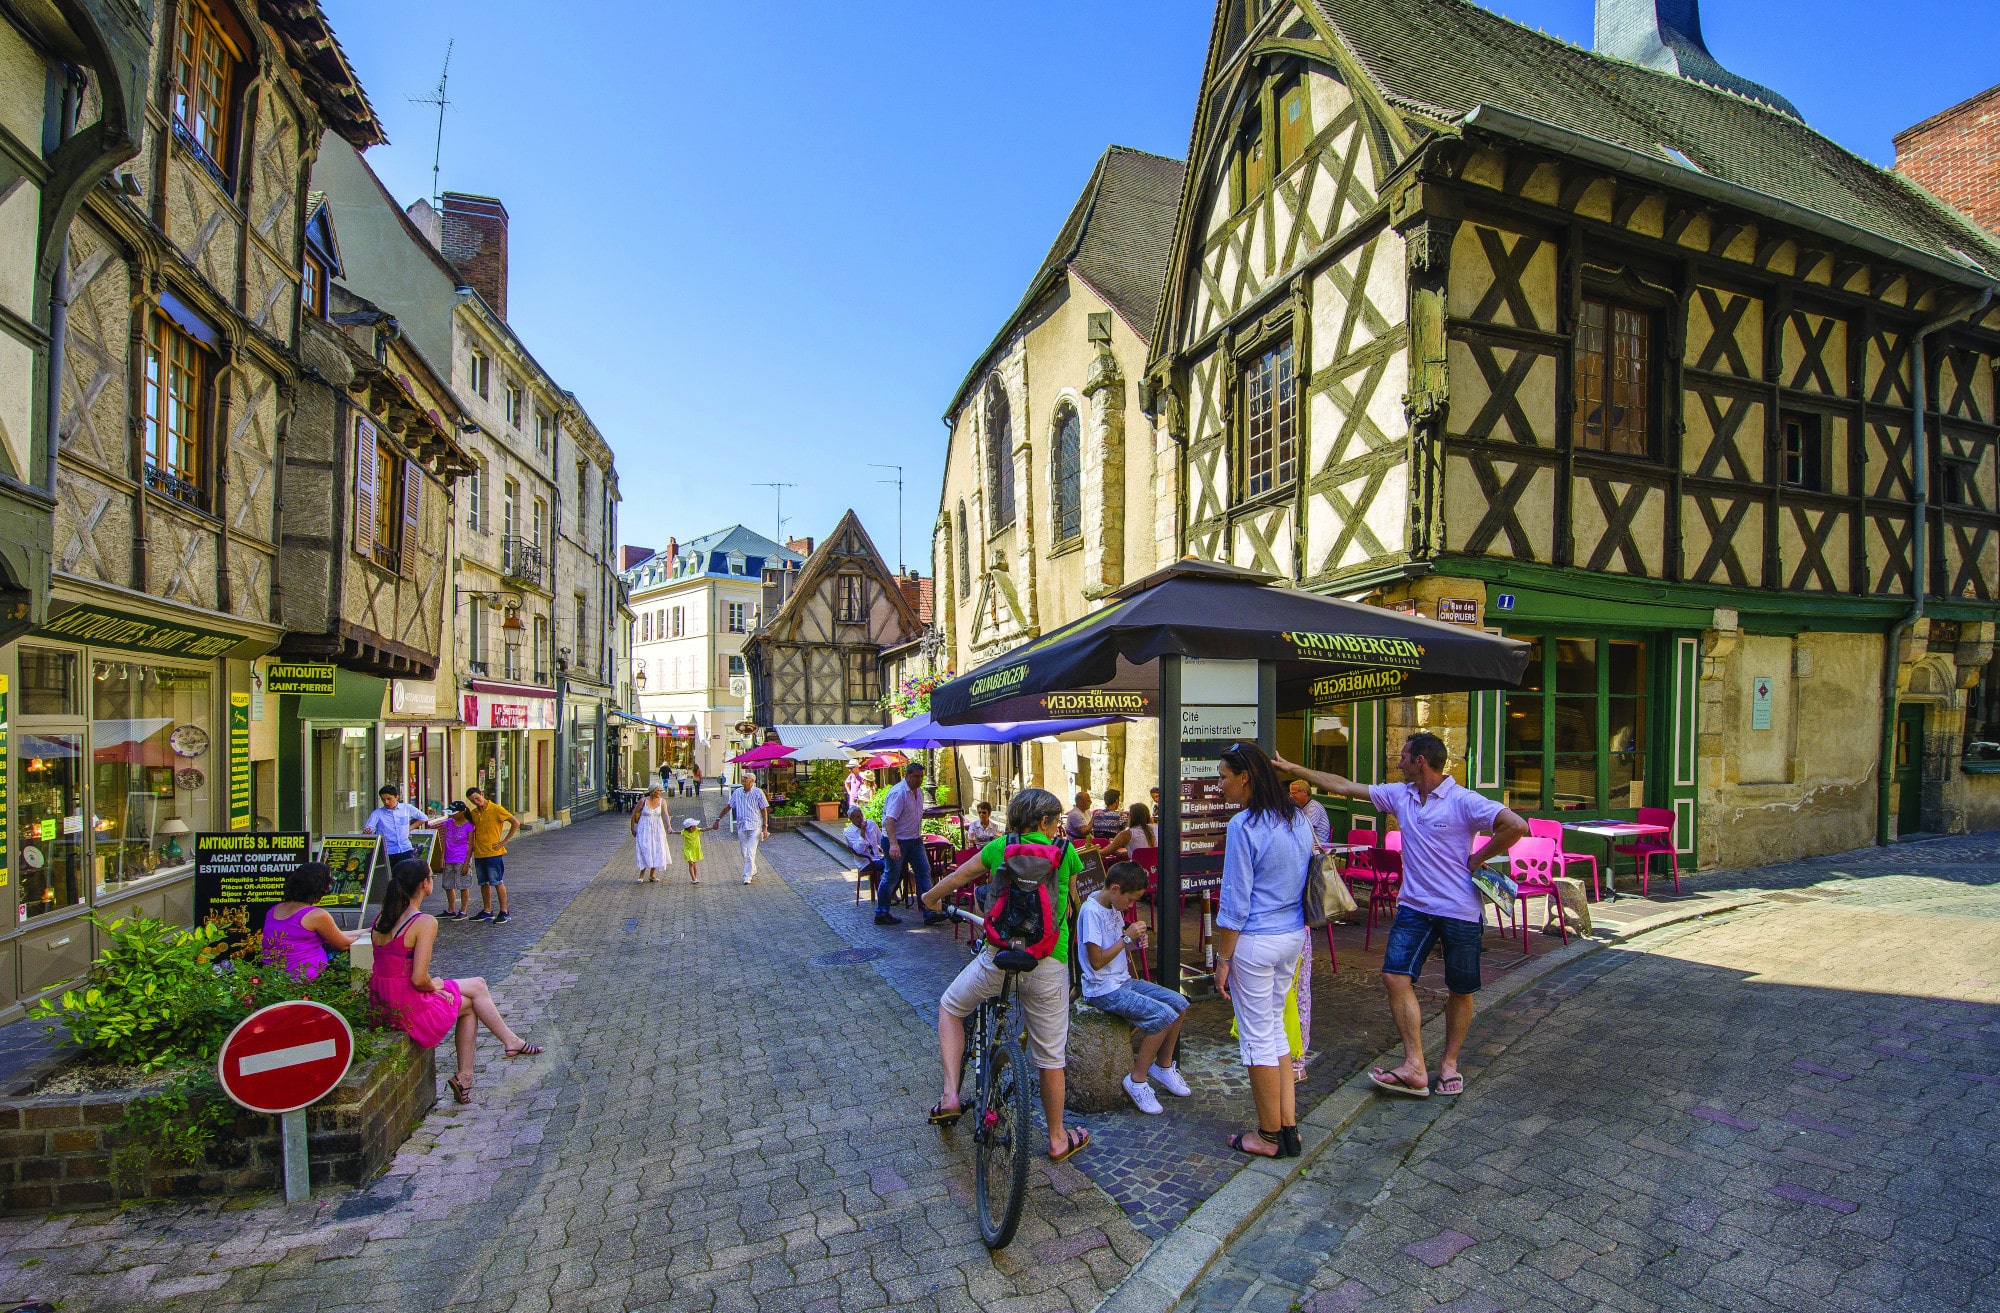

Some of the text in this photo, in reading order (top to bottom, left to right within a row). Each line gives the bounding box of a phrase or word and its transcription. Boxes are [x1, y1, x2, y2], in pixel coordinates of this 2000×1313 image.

[1451, 601, 1474, 611] Rue des
[1454, 612, 1476, 621] PILIERS
[41, 611, 156, 644] ANTIQUITES
[1291, 631, 1420, 658] GRIMBERGEN
[270, 667, 332, 679] ANTIQUITES
[972, 664, 1028, 696] GRIMBERGEN
[270, 682, 333, 692] SAINT-PIERRE
[494, 704, 526, 716] La Semaine
[500, 716, 508, 726] de
[1182, 711, 1199, 722] Cité
[1182, 725, 1242, 735] Administrative
[1191, 765, 1212, 773] Théâtre
[1190, 803, 1208, 813] Eglise
[1190, 822, 1210, 830] Jardin
[199, 834, 256, 850] ANTIQUITÉS
[272, 836, 305, 849] PIERRE
[210, 853, 297, 863] ACHAT COMPTANT
[199, 864, 258, 874] ESTIMATION
[1190, 879, 1198, 887] La
